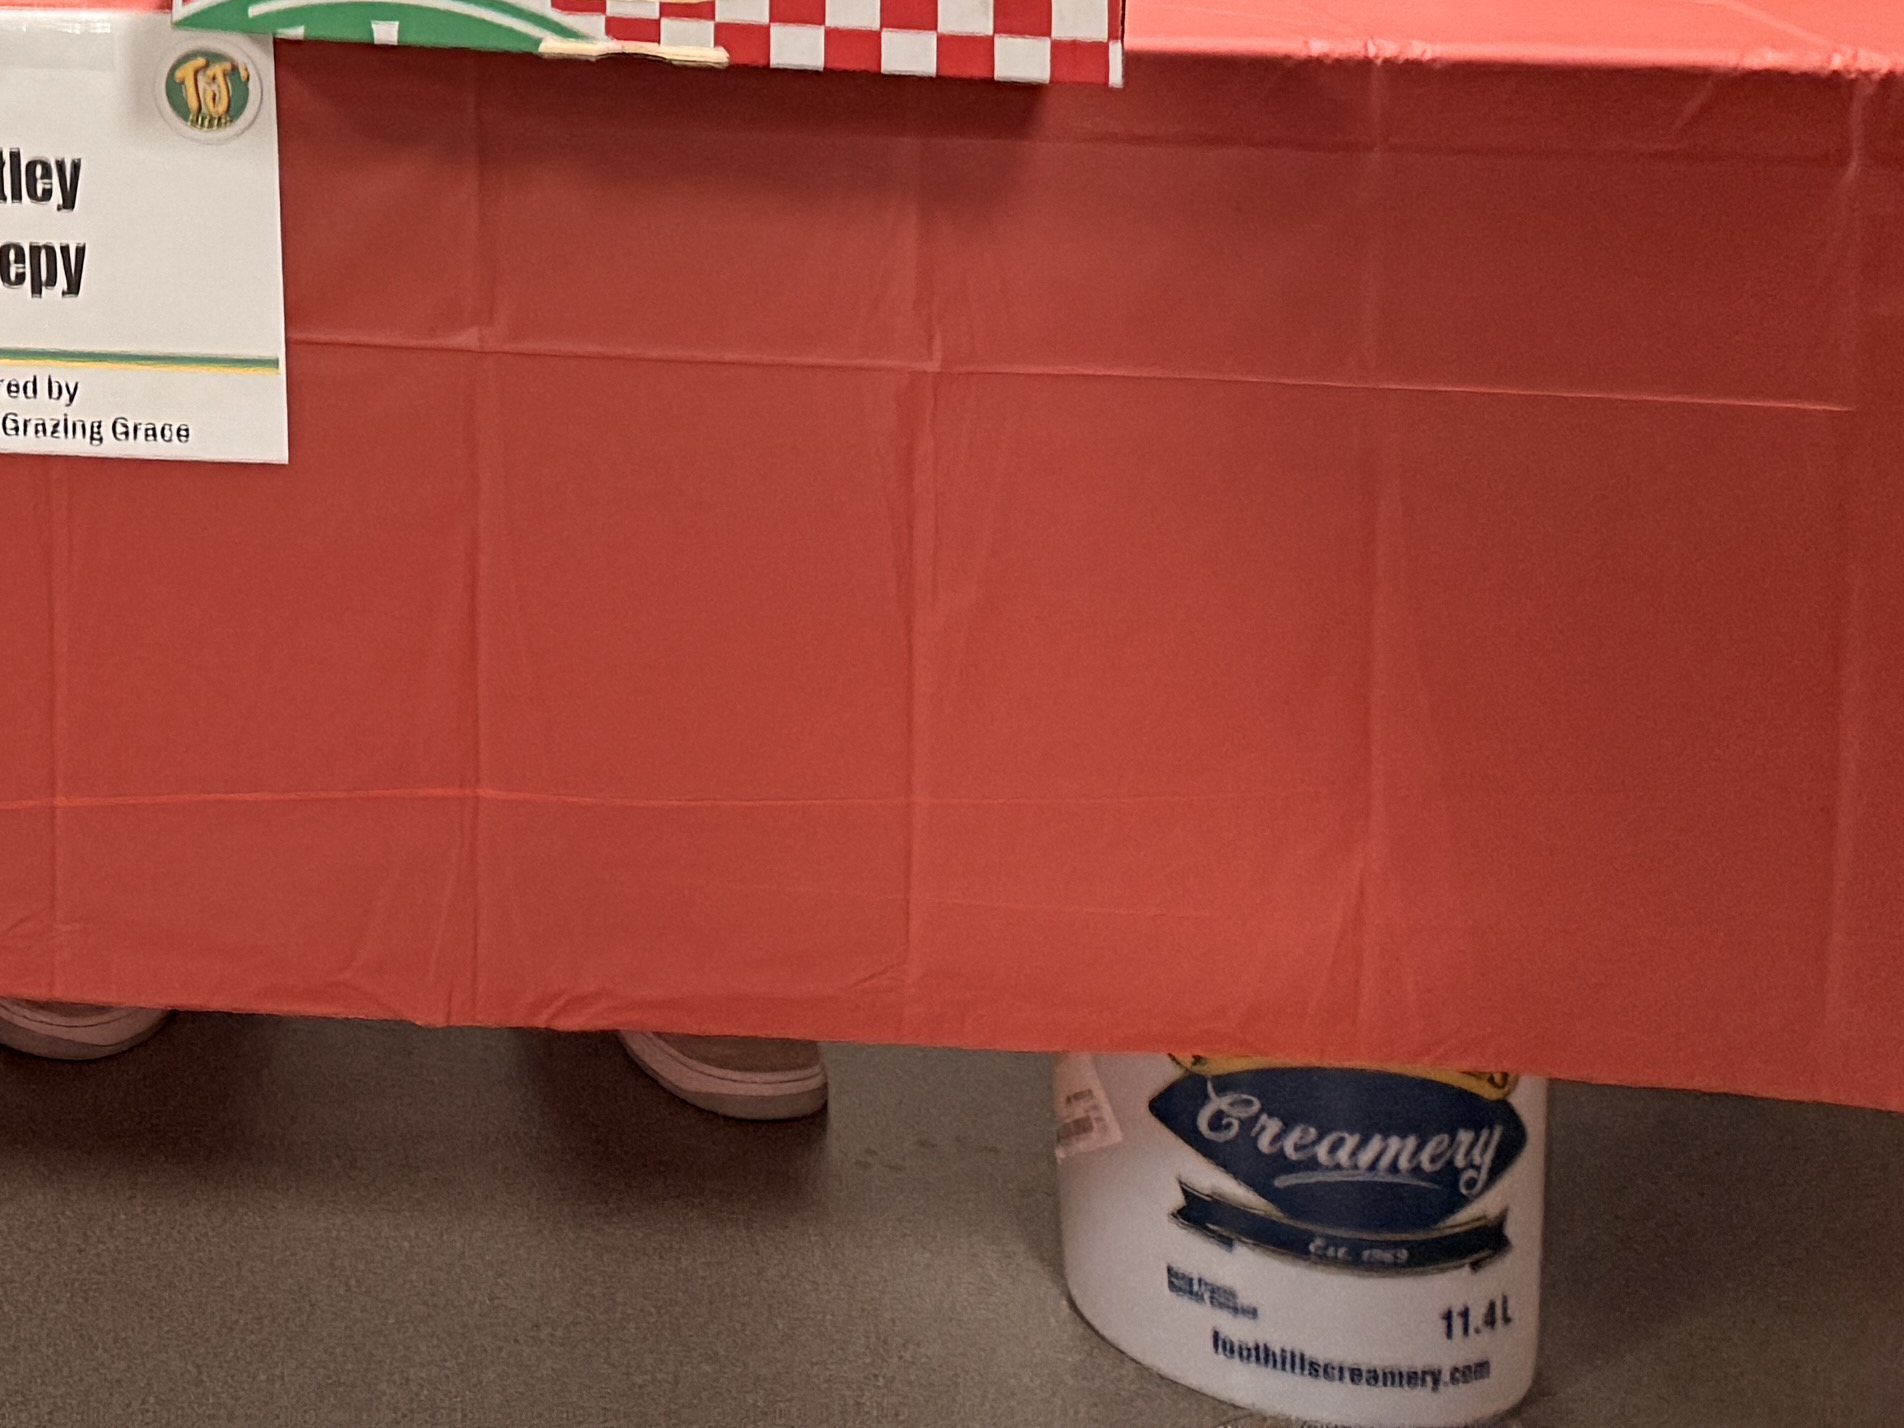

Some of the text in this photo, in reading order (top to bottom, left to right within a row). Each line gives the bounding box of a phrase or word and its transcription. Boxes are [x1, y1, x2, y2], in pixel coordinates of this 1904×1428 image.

[47, 375, 80, 404] by
[2, 412, 103, 445] Grazing
[112, 417, 191, 443] Grace
[1196, 1080, 1503, 1197] Creamery
[1213, 1329, 1490, 1393] foothillscreamery.com
